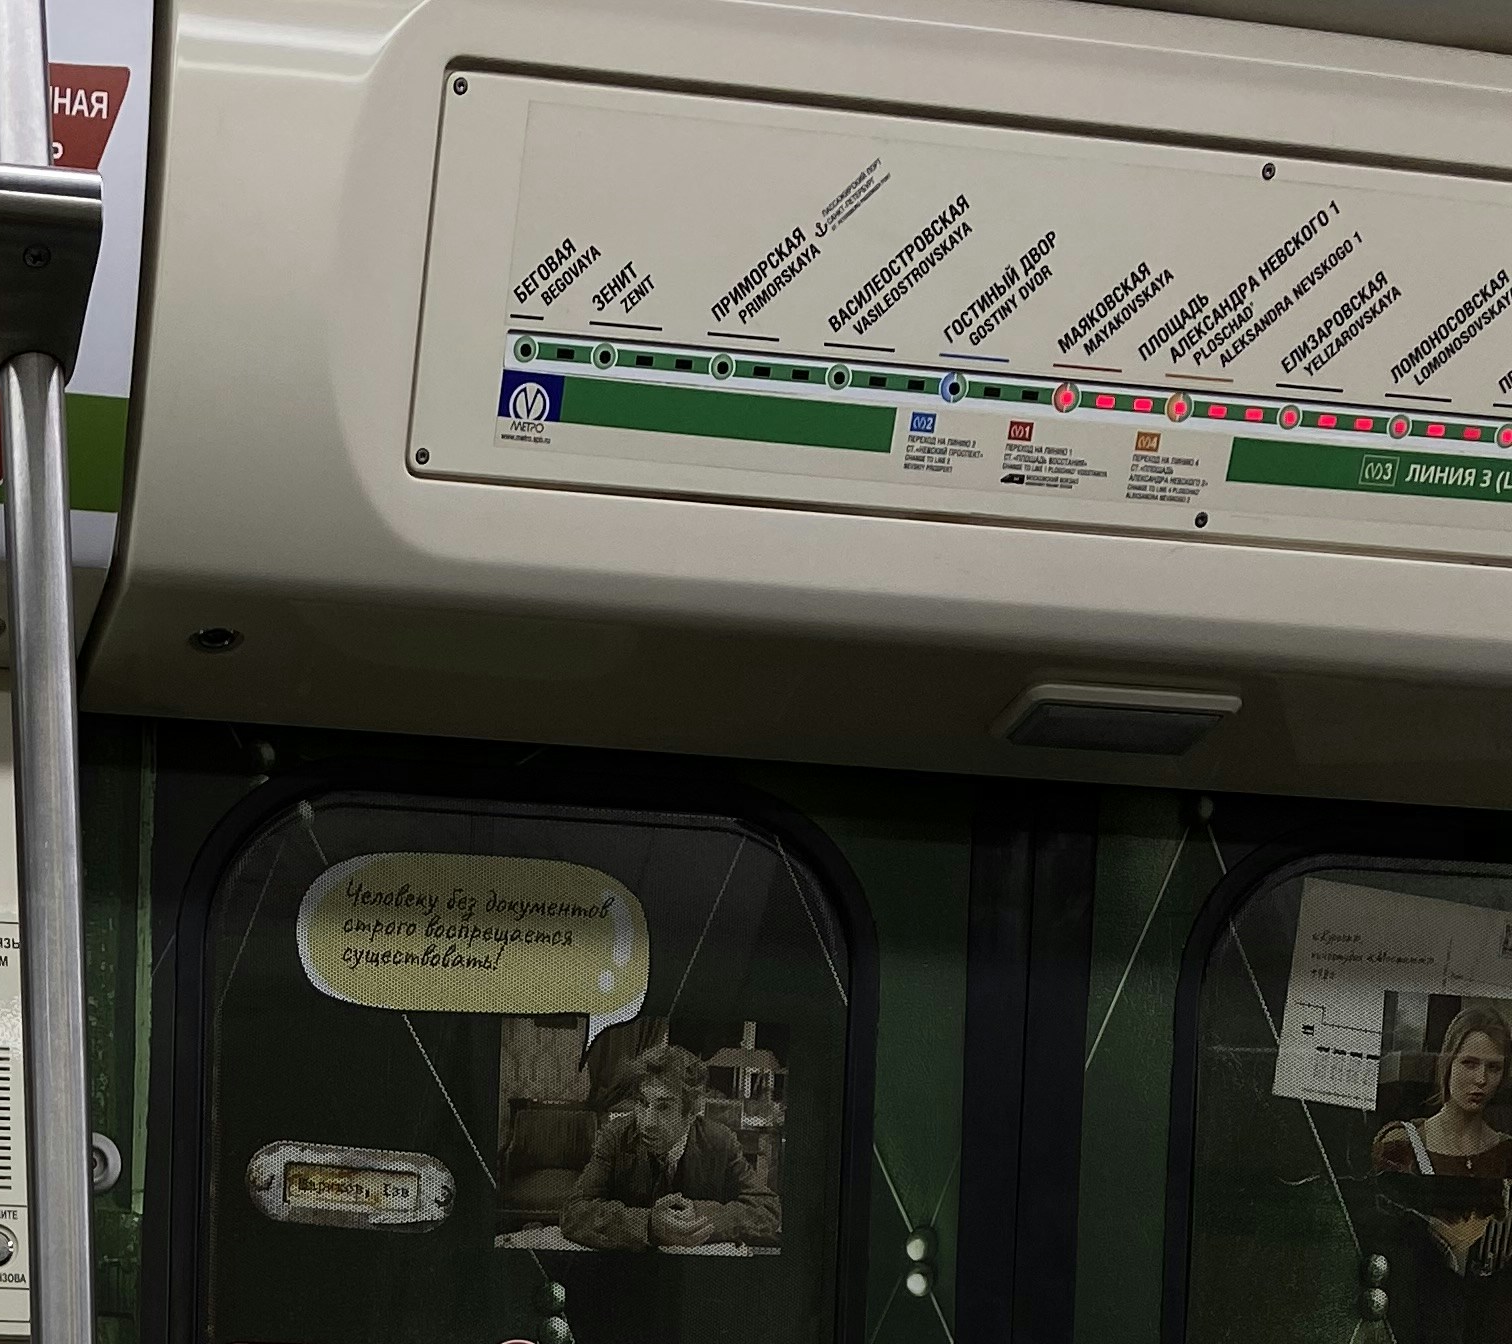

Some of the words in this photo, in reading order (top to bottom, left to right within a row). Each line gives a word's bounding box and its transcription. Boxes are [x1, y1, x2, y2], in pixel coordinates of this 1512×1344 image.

[512, 237, 577, 304] БЕГОВАЯ
[540, 245, 602, 307] BEGOVAYA
[591, 261, 639, 312] ЗЕНИТ
[621, 274, 656, 314] ZENIT
[711, 226, 806, 322] ПРИМОРСКАЯ
[738, 243, 821, 325] PRIMORSKAYA
[828, 193, 970, 333] ВАСИЛЕОСТРОВСКАЯ
[852, 221, 973, 335] VASILEOSTROVSKAYA
[943, 264, 1021, 343] ГОСТИНЫЙ
[1019, 231, 1056, 277] ДВОР
[1169, 275, 1261, 364] АЛЕКСАНДРА
[1258, 210, 1329, 281] НЕВСКОГО
[1329, 200, 1340, 215] 1
[1219, 295, 1294, 368] ALEKSANDRA
[1292, 239, 1354, 300] NEVSKOGO
[1353, 231, 1364, 243] 1
[969, 294, 1019, 346] GOSTINY
[1018, 264, 1053, 301] DVOR
[1057, 261, 1151, 354] МАЯКОВСКАЯ
[1083, 269, 1174, 356] MAYAKOVSKAYA
[1138, 293, 1209, 361] ПЛОЩАДЬ
[1281, 271, 1389, 374] ЕЛИЗАРОВСКАЯ
[1304, 286, 1402, 376] YELIZAROVSKAYA
[1390, 269, 1510, 384] ЛОМОНОСОВСКАЯ
[510, 420, 545, 435] МЕТРО
[1405, 463, 1476, 487] ЛИНИЯ
[1480, 469, 1492, 488] 3
[343, 918, 416, 942] строго
[425, 918, 573, 946] воспрещается
[346, 879, 437, 916] Человеку
[447, 887, 476, 922] без
[485, 895, 615, 921] документов
[342, 945, 505, 972] существовать!
